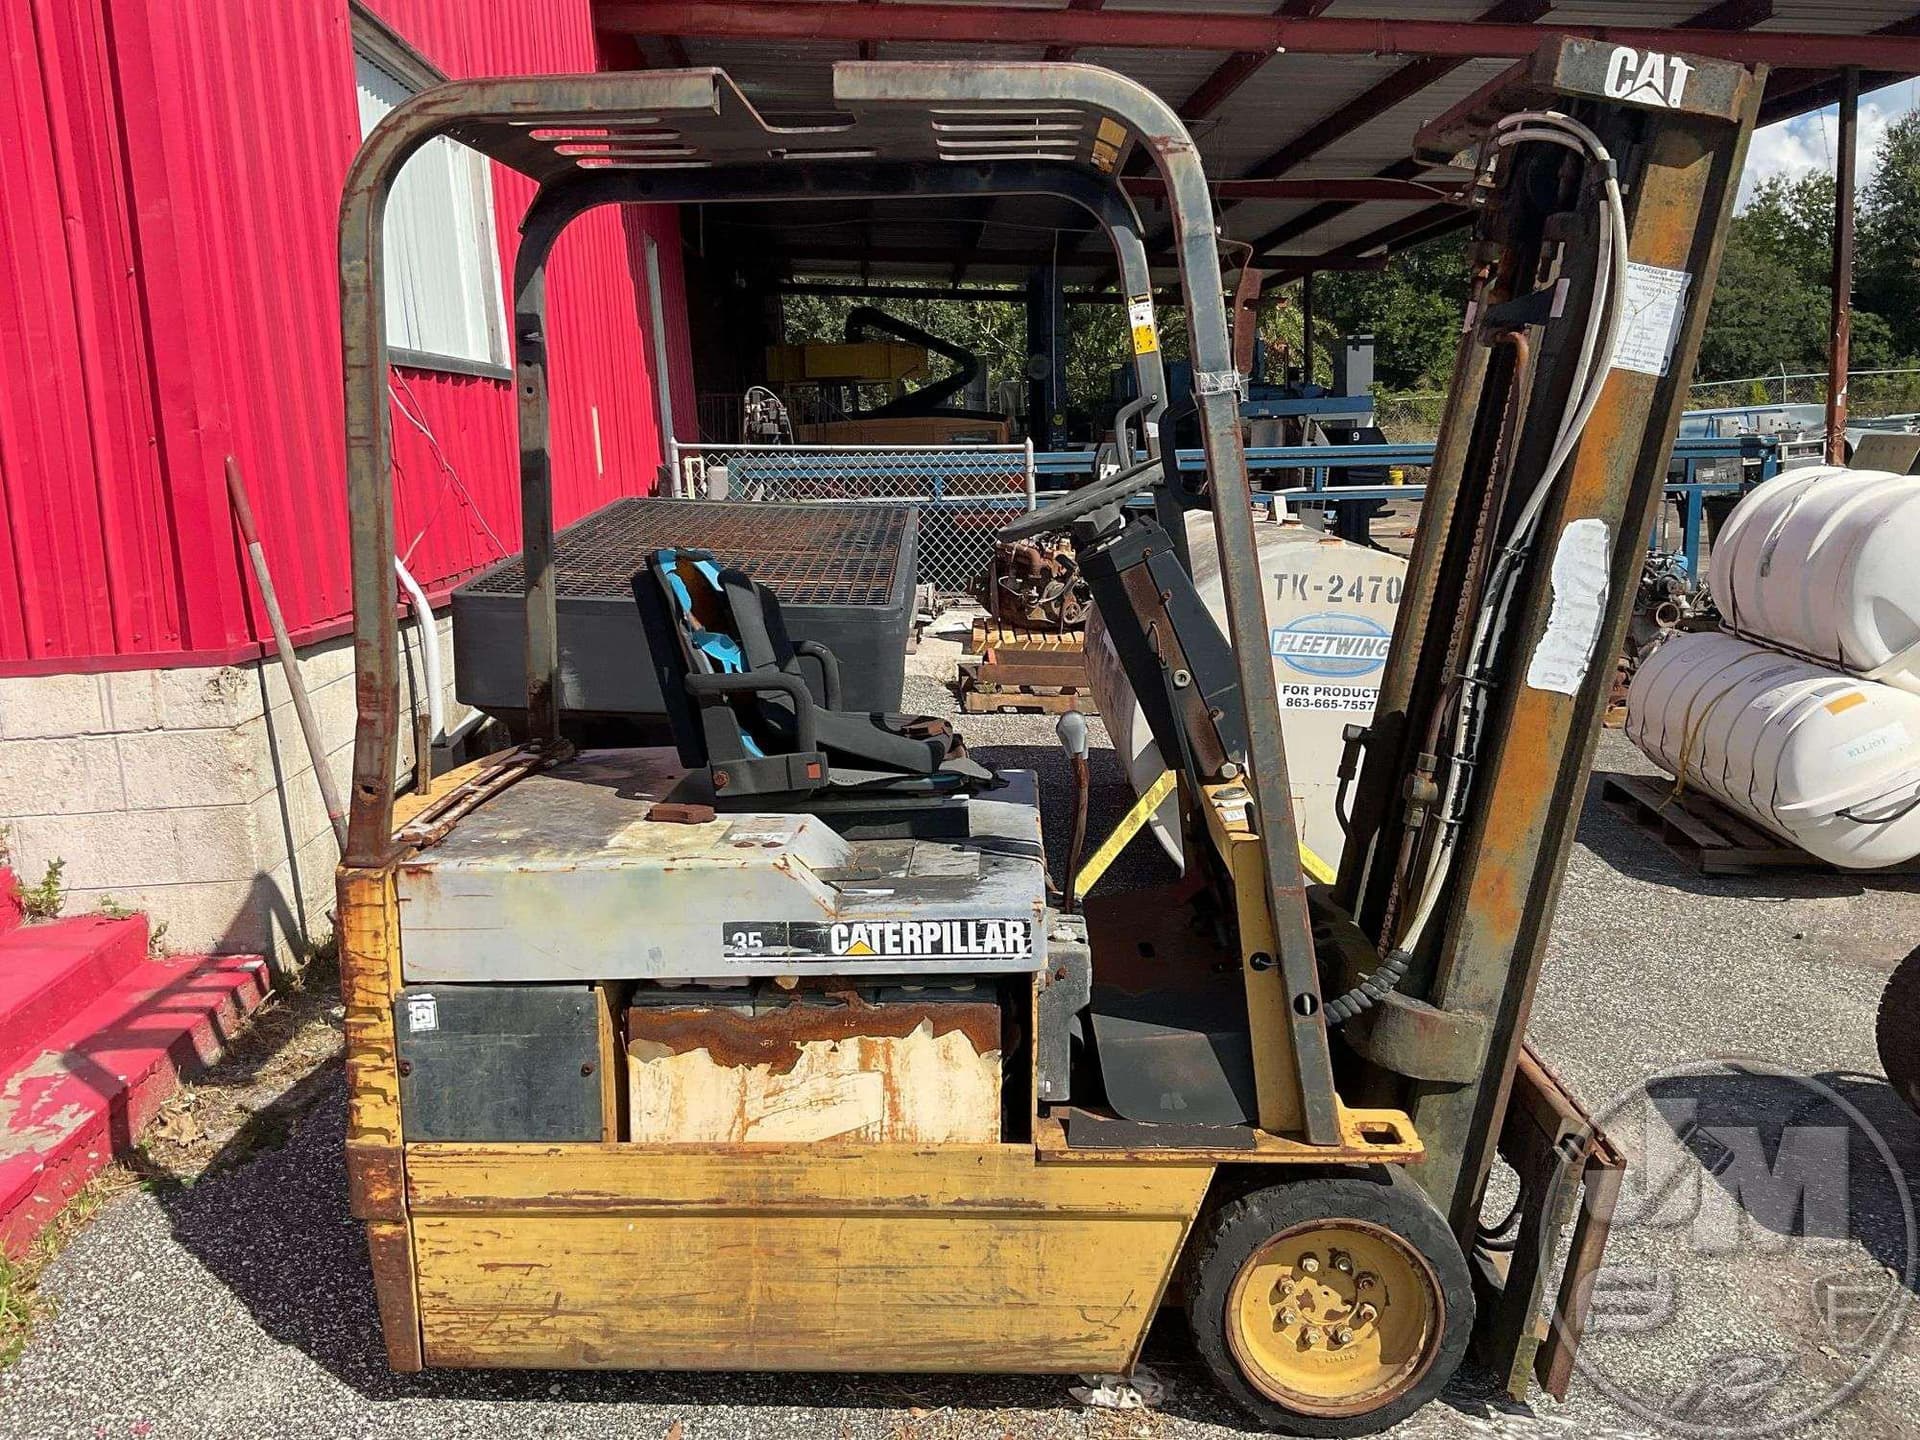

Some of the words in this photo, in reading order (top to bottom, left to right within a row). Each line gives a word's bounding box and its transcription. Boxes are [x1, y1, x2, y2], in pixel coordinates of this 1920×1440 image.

[1604, 46, 1695, 108] CAT
[1274, 573, 1402, 604] TK-2470
[1277, 633, 1390, 657] FLEETWING
[1282, 685, 1309, 696] FOR
[1313, 686, 1380, 699] PRODUCT
[1286, 697, 1375, 711] 863-665-7557
[732, 931, 763, 956] 35
[830, 919, 1027, 956] CATERPILLAR
